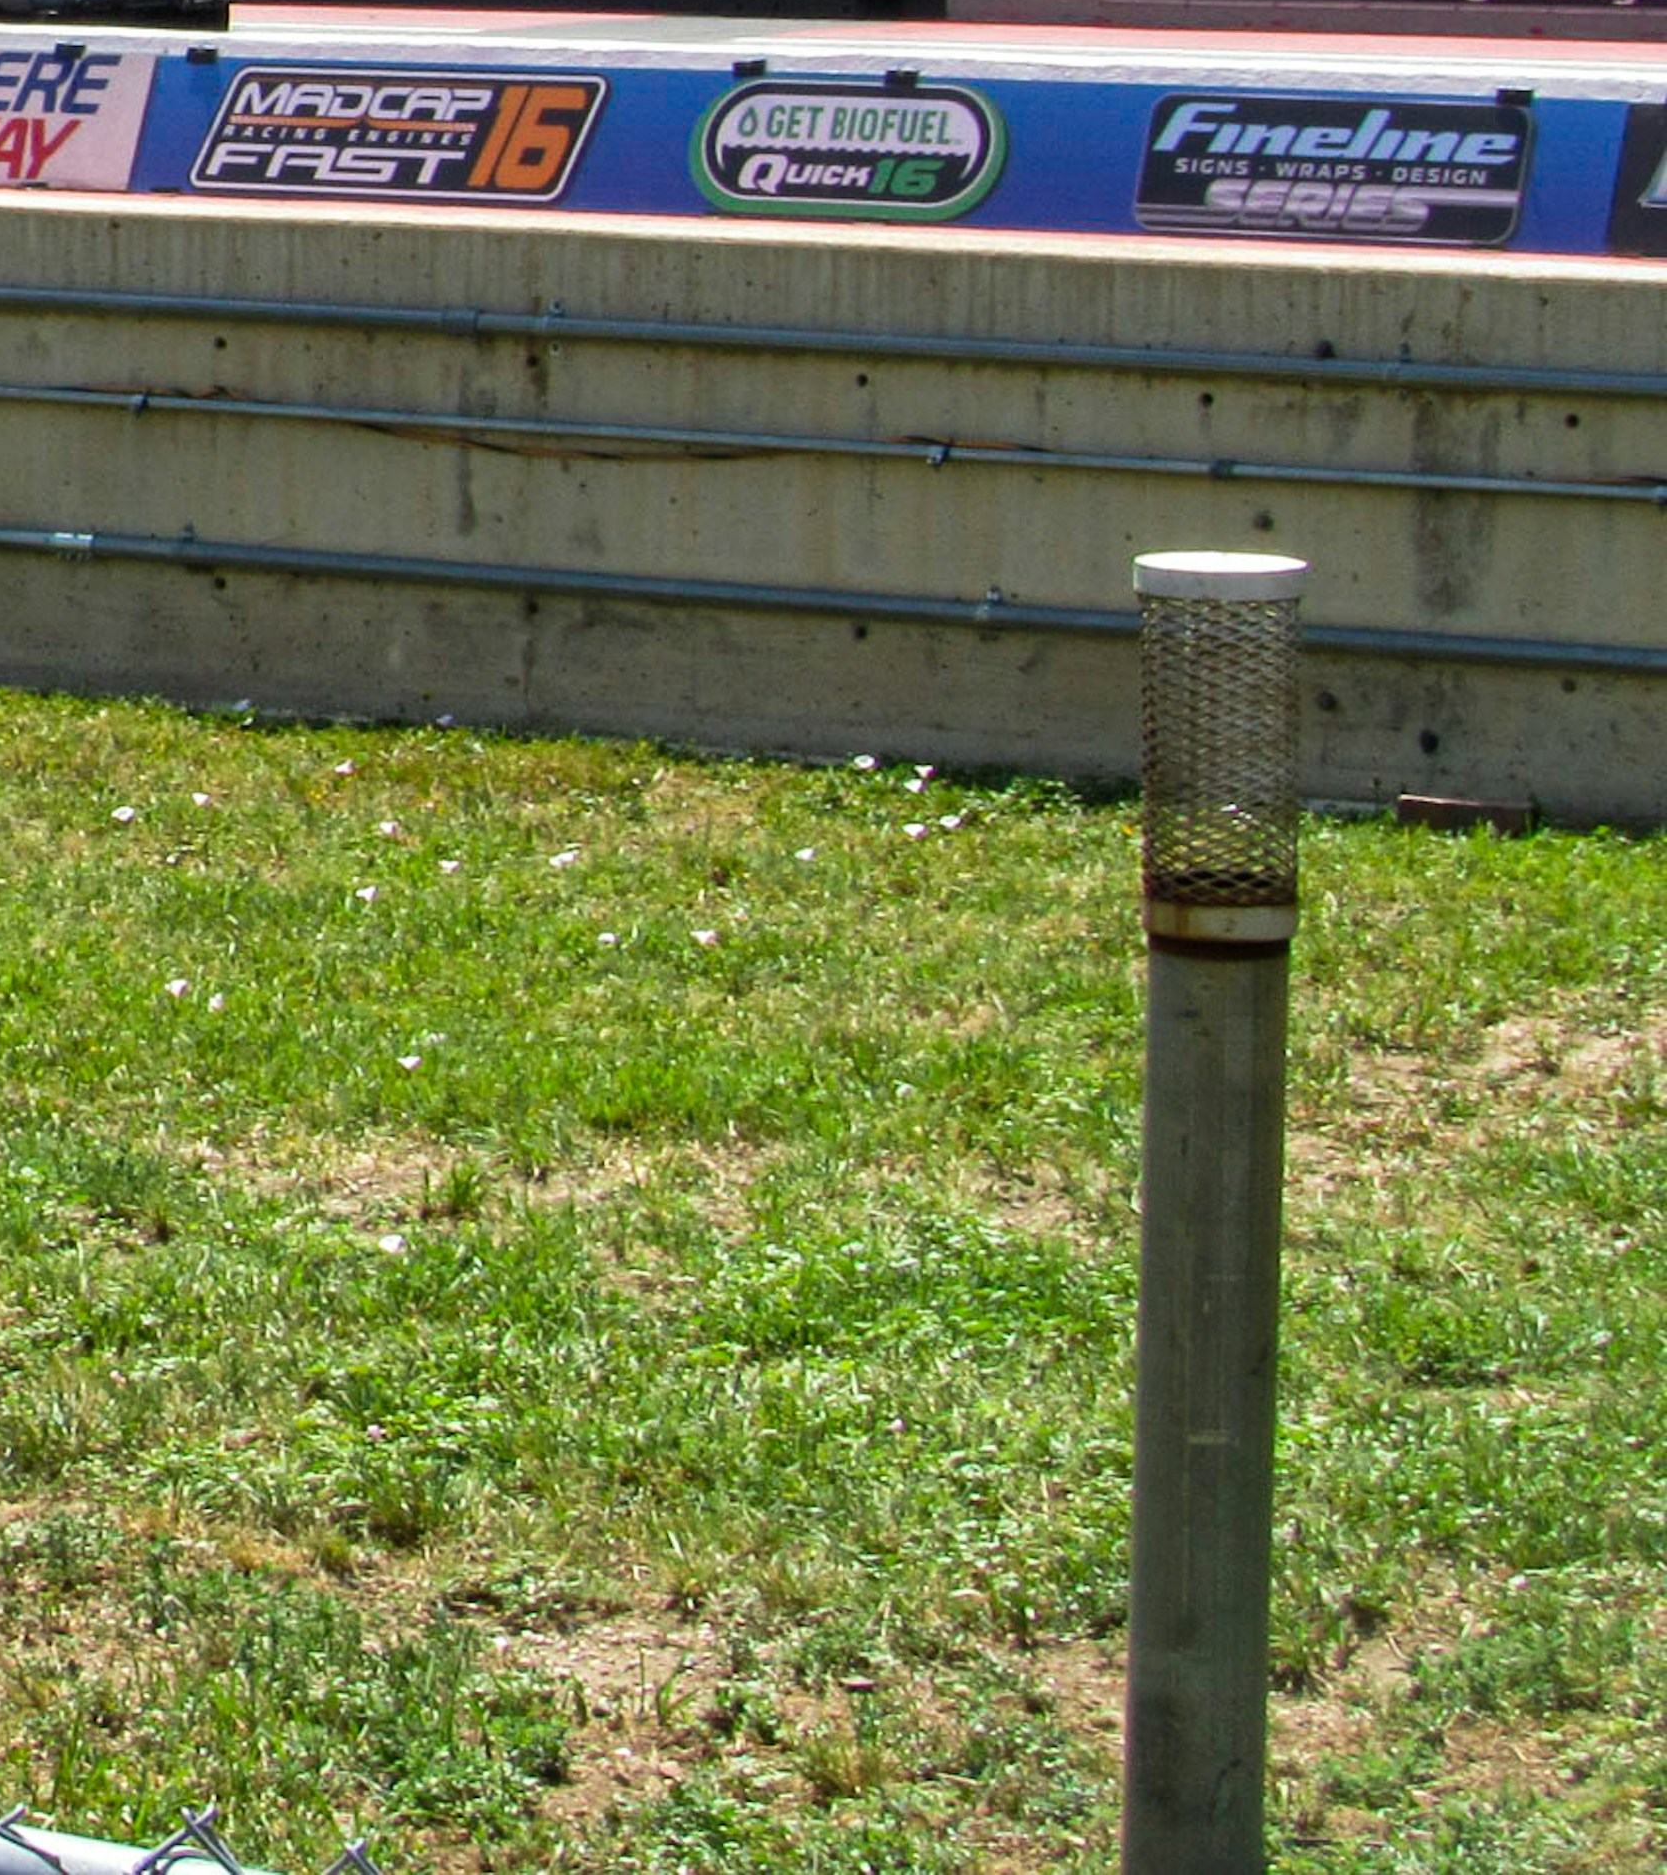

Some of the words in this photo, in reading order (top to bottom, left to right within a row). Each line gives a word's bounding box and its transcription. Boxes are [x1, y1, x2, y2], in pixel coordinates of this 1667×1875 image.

[222, 126, 326, 141] RACING
[348, 130, 478, 146] ENGINES
[233, 81, 496, 122] MADCAP
[467, 85, 589, 189] 16
[767, 105, 824, 140] GET
[830, 107, 951, 145] BIOFUEL
[205, 142, 466, 185] FAST
[869, 158, 946, 196] 16
[1175, 158, 1251, 175] SIGNS
[1276, 162, 1366, 181] WRAPS
[1392, 166, 1489, 186] DESIGN
[1205, 178, 1430, 232] SERIES
